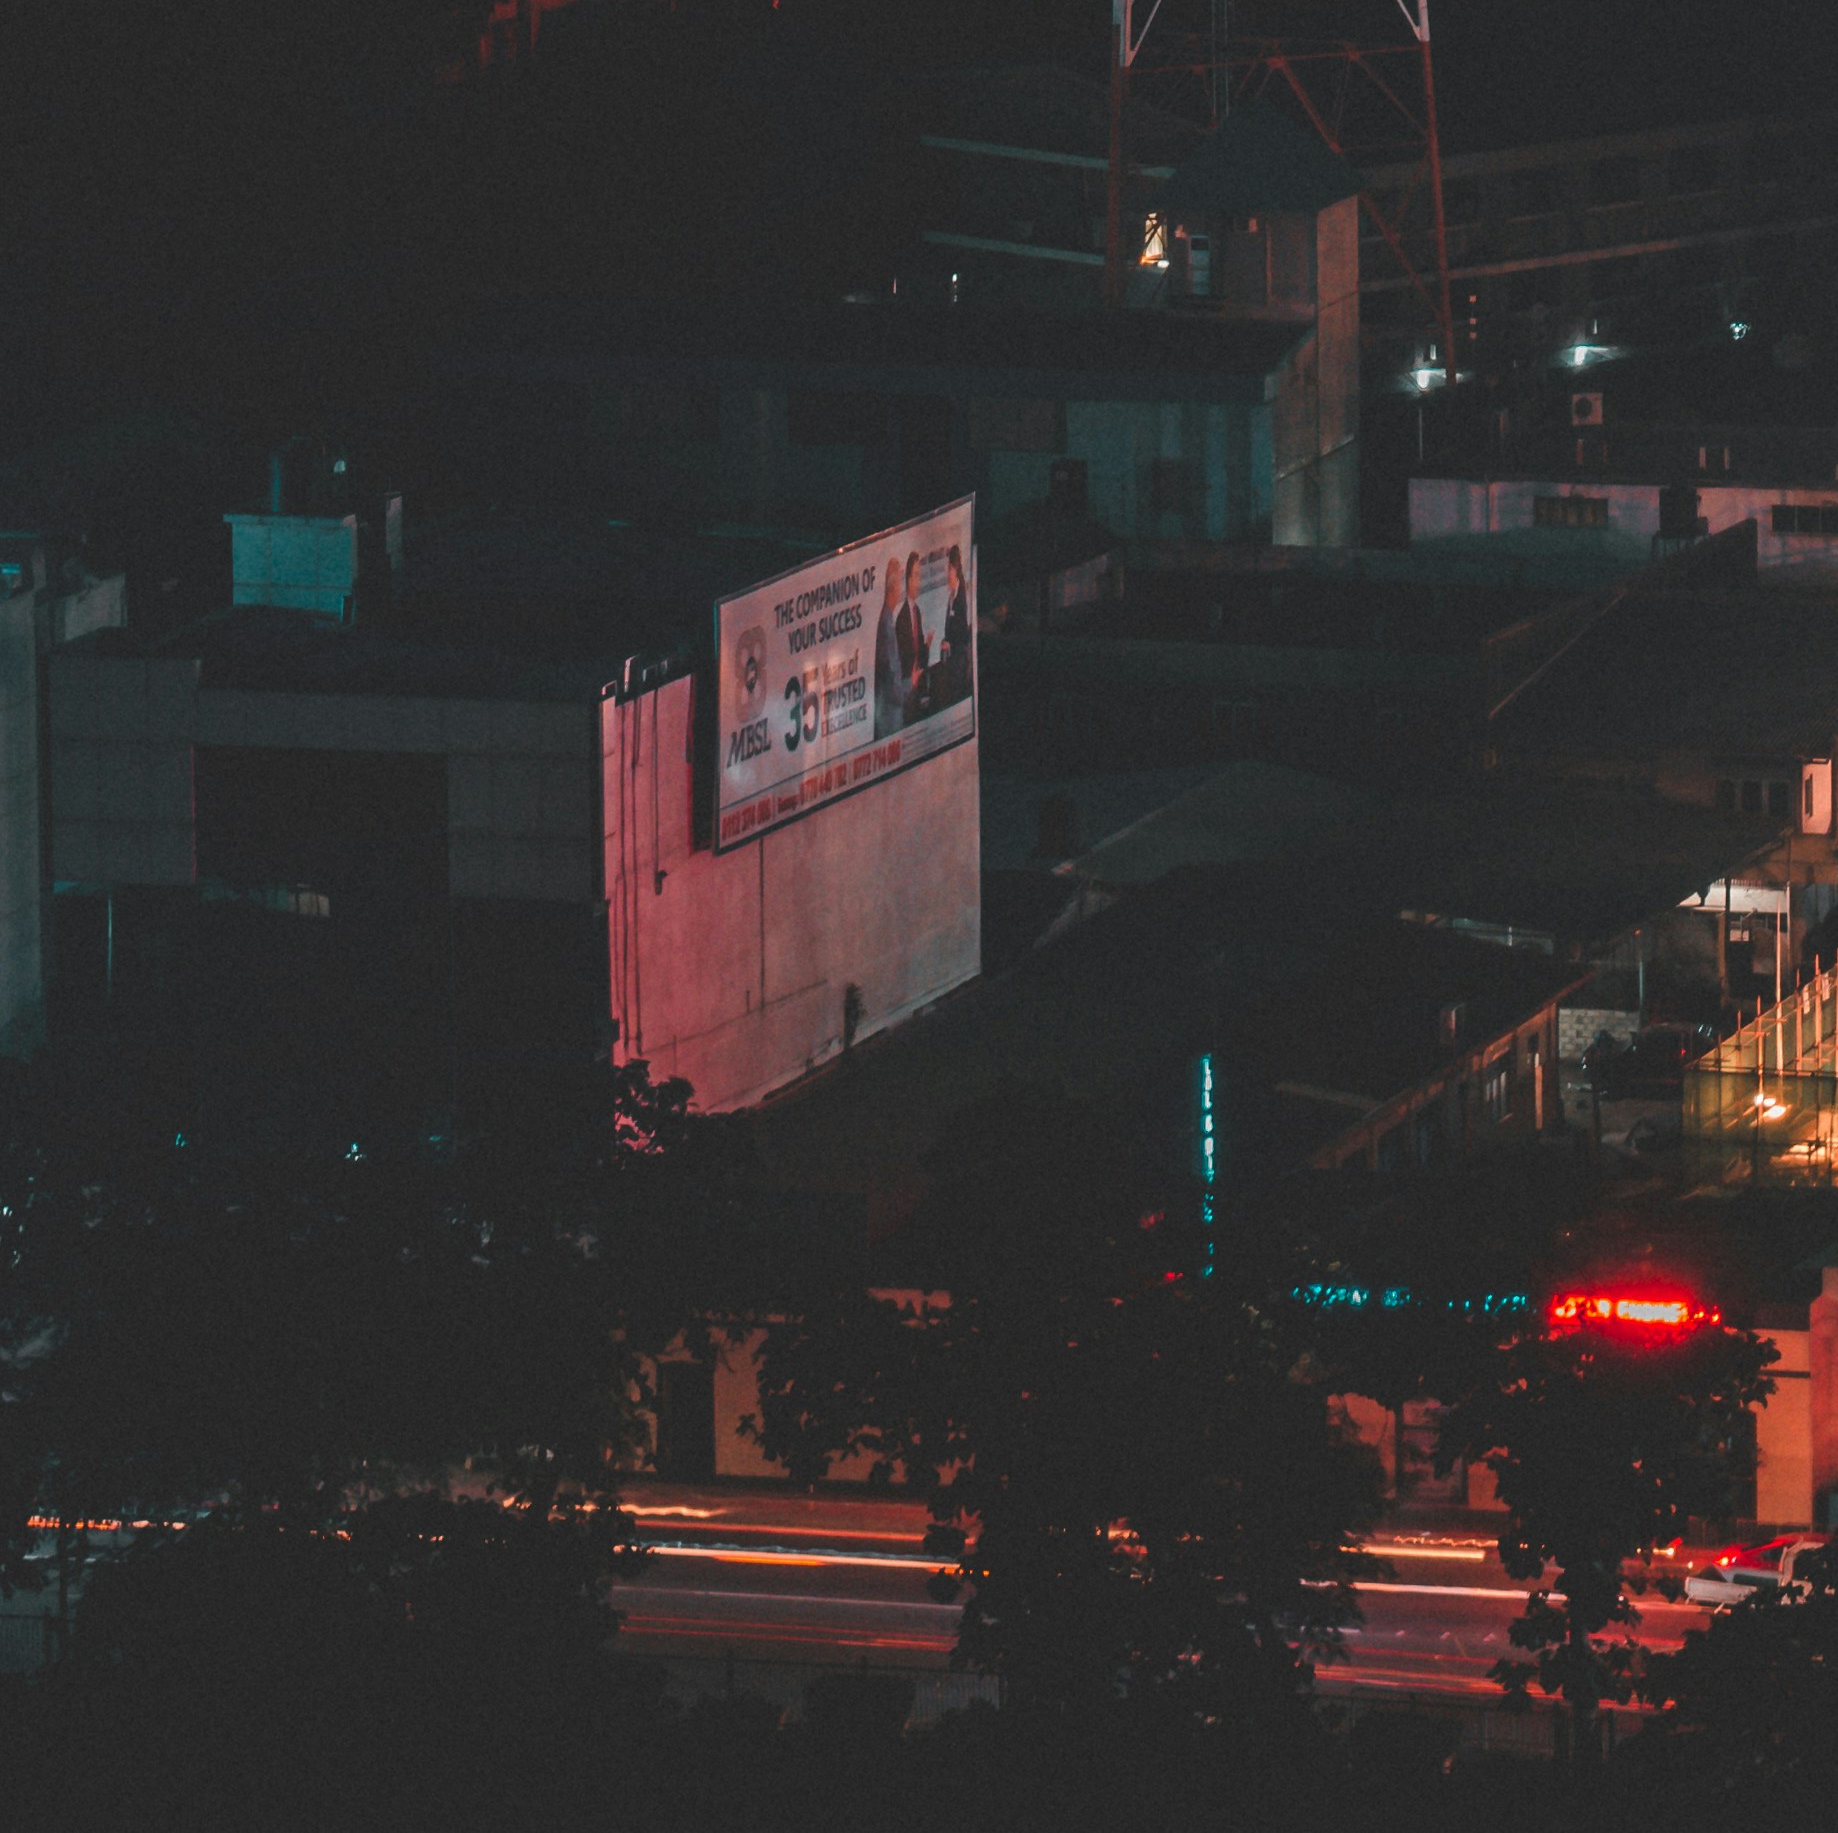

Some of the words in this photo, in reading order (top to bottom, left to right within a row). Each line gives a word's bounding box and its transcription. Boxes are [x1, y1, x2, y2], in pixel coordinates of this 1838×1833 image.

[774, 598, 794, 629] THE
[796, 573, 859, 619] COMPANION
[862, 566, 875, 593] OF
[788, 622, 816, 655] YOUR
[819, 601, 862, 643] SUCCESS
[784, 667, 819, 752] 35
[726, 717, 772, 769] MBSL
